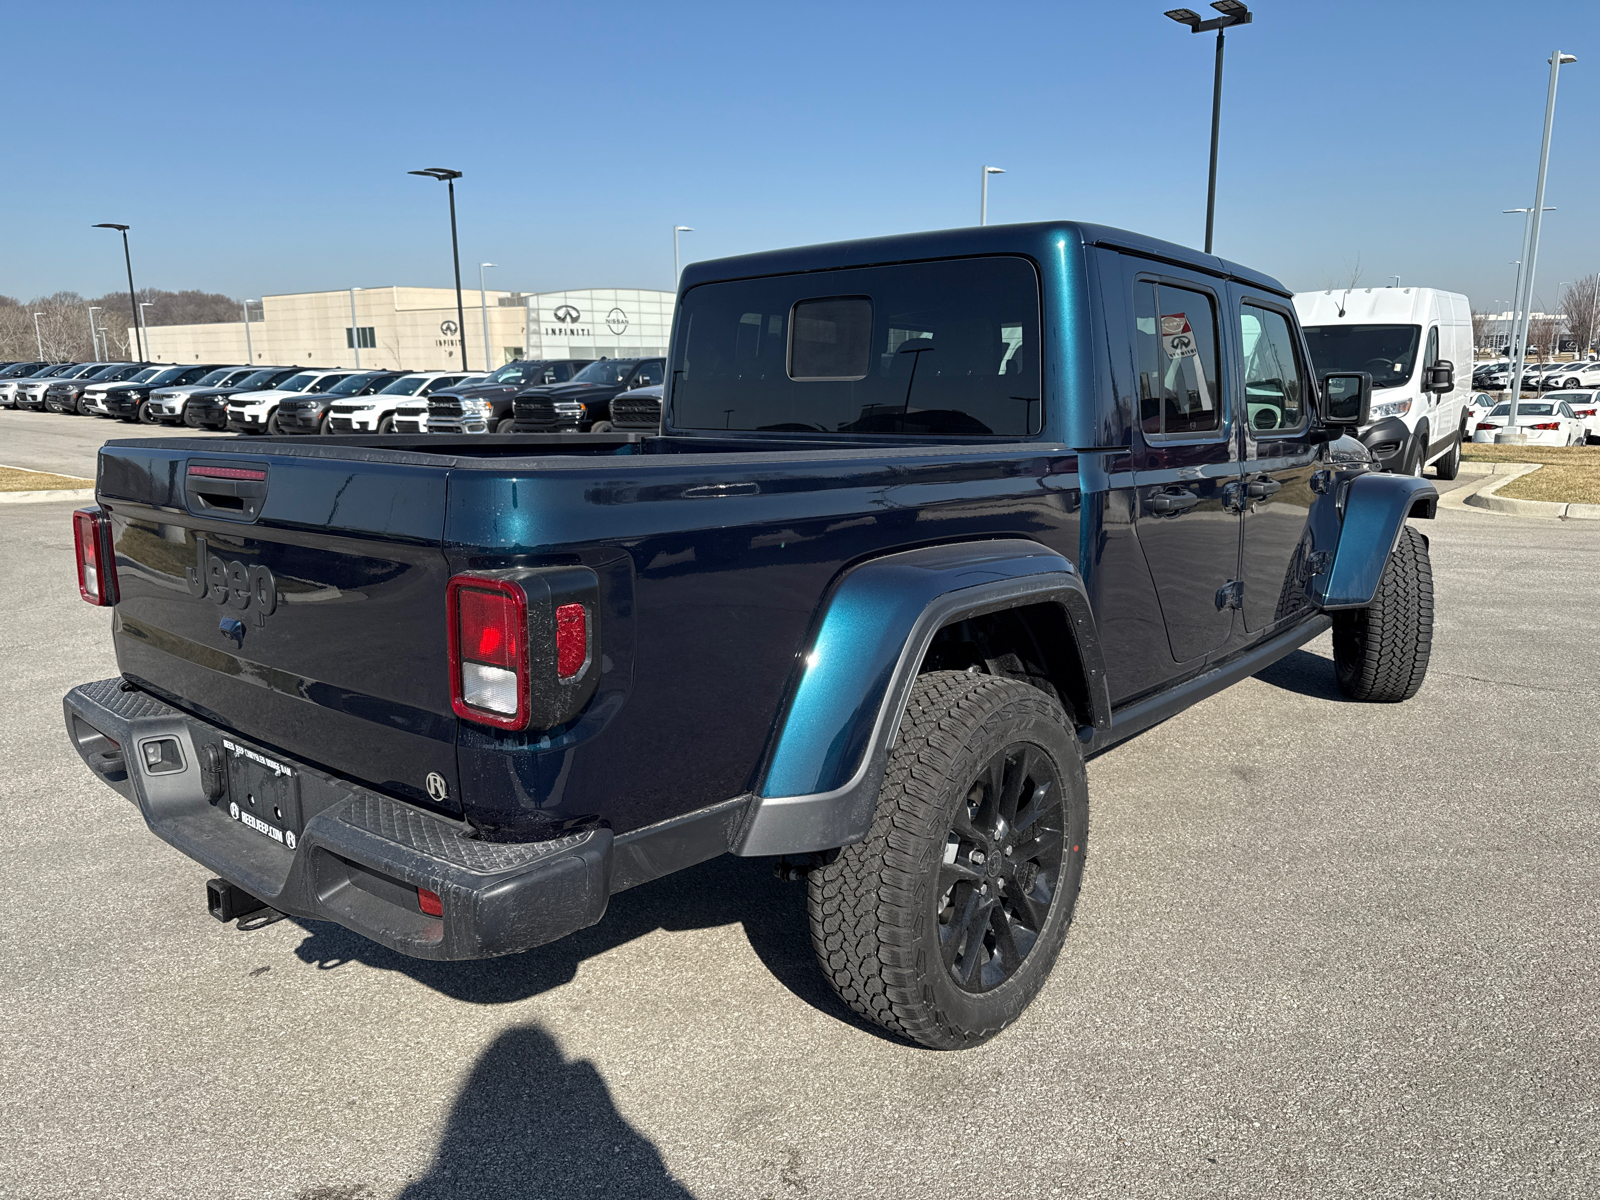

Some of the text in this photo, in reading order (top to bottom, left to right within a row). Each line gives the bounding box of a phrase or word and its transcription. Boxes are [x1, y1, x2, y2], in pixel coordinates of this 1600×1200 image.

[545, 327, 590, 337] INFINITI
[435, 339, 462, 347] INFINIT
[185, 537, 278, 627] Jeep
